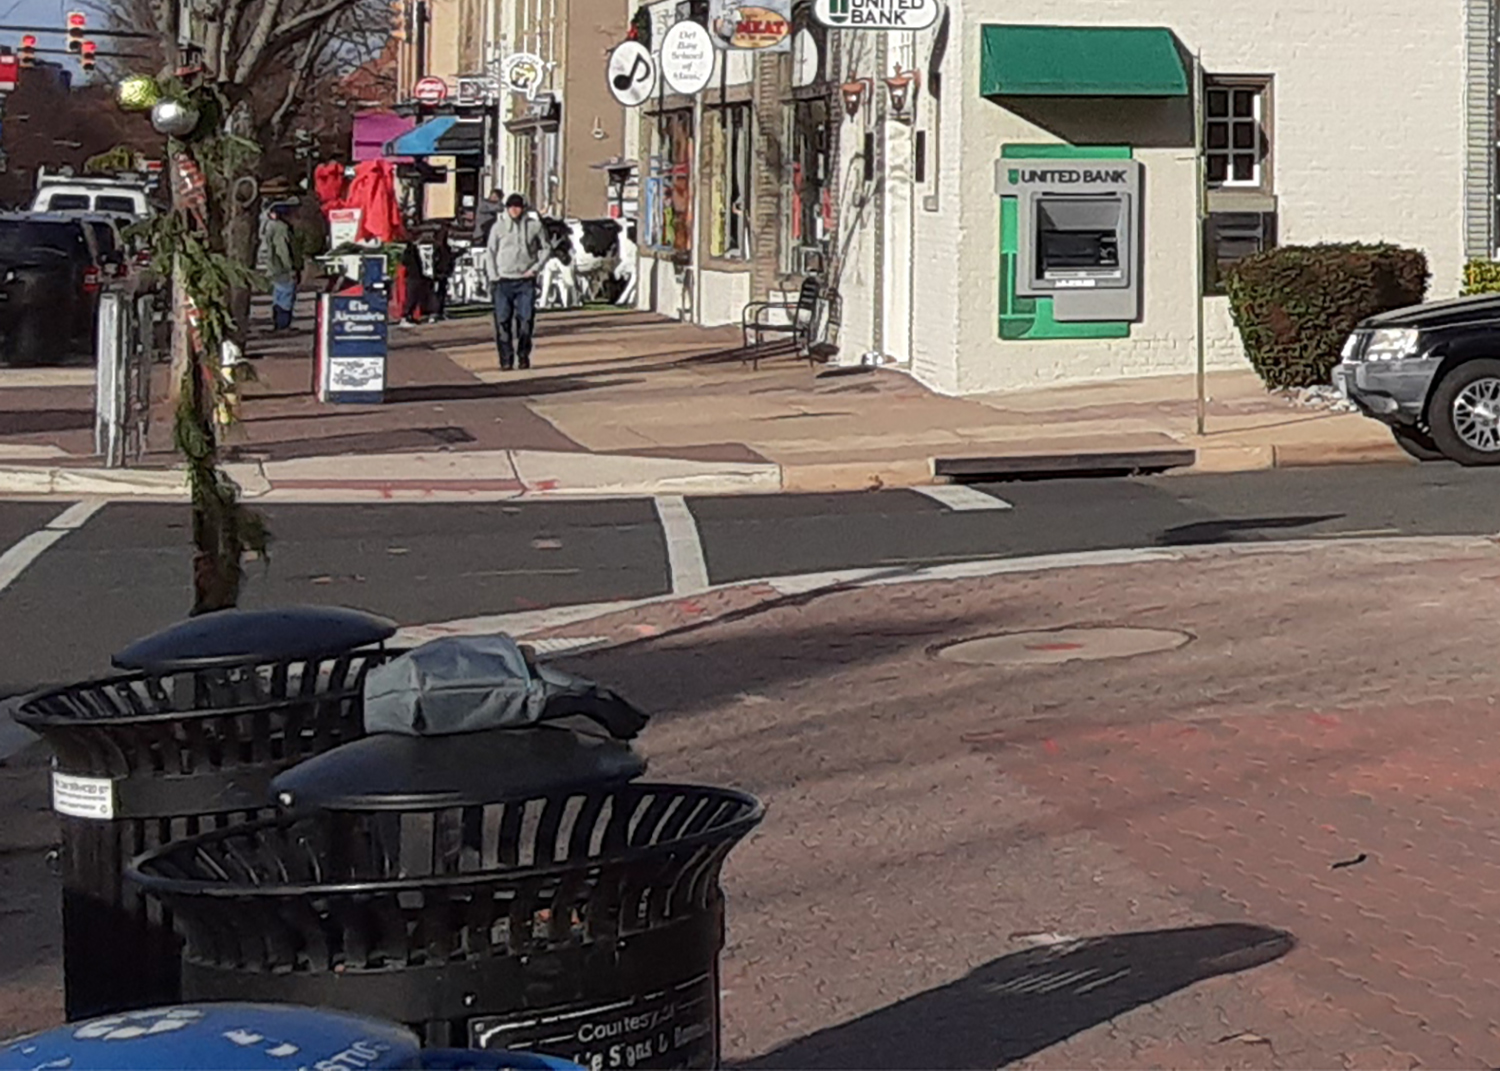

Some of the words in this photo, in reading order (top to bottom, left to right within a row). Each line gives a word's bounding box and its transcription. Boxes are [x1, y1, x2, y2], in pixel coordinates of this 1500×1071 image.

[850, 9, 907, 25] BANK
[1020, 169, 1081, 184] UNITED
[1082, 169, 1128, 184] BANK
